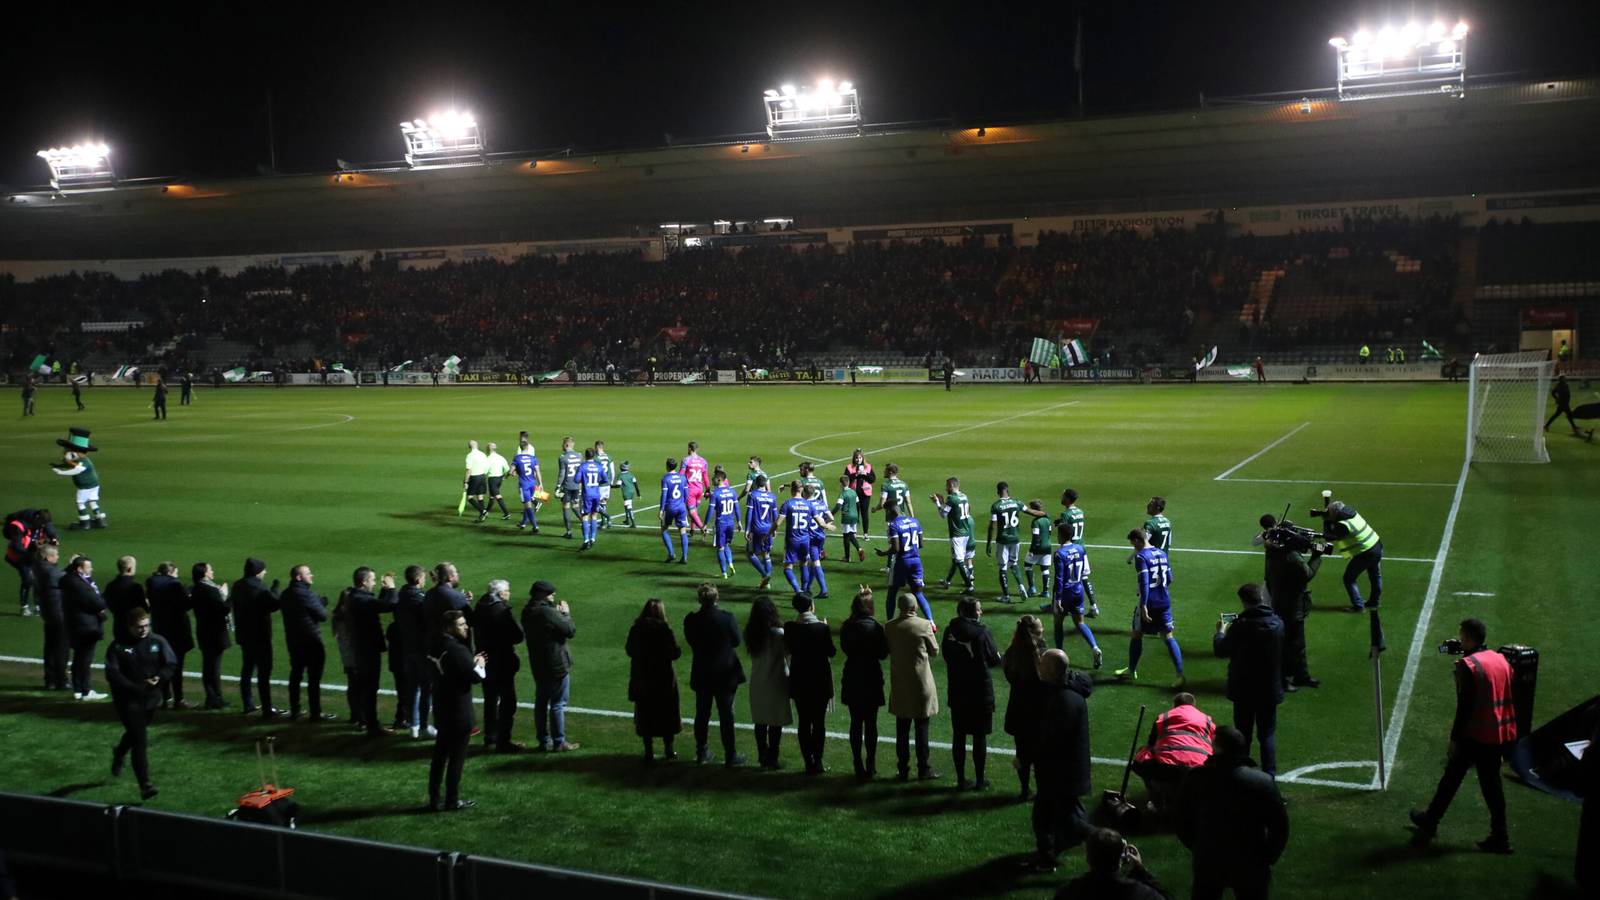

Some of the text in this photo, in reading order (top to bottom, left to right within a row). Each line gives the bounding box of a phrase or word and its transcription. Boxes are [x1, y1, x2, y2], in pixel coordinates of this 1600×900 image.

[1296, 205, 1401, 219] TARGET TRAVEL
[1108, 218, 1144, 228] RADIO
[459, 373, 480, 382] TAXI
[1099, 369, 1133, 378] CORNWALL
[523, 463, 532, 476] 5
[587, 472, 599, 486] 11
[672, 484, 681, 499] 6
[896, 489, 904, 505] 5
[720, 500, 734, 515] 10
[761, 503, 770, 520] 7
[791, 512, 808, 529] 15
[1002, 510, 1019, 529] 16
[1071, 521, 1085, 541] 17
[902, 530, 919, 552] 24
[1160, 530, 1169, 550] 7
[1067, 560, 1083, 584] 17
